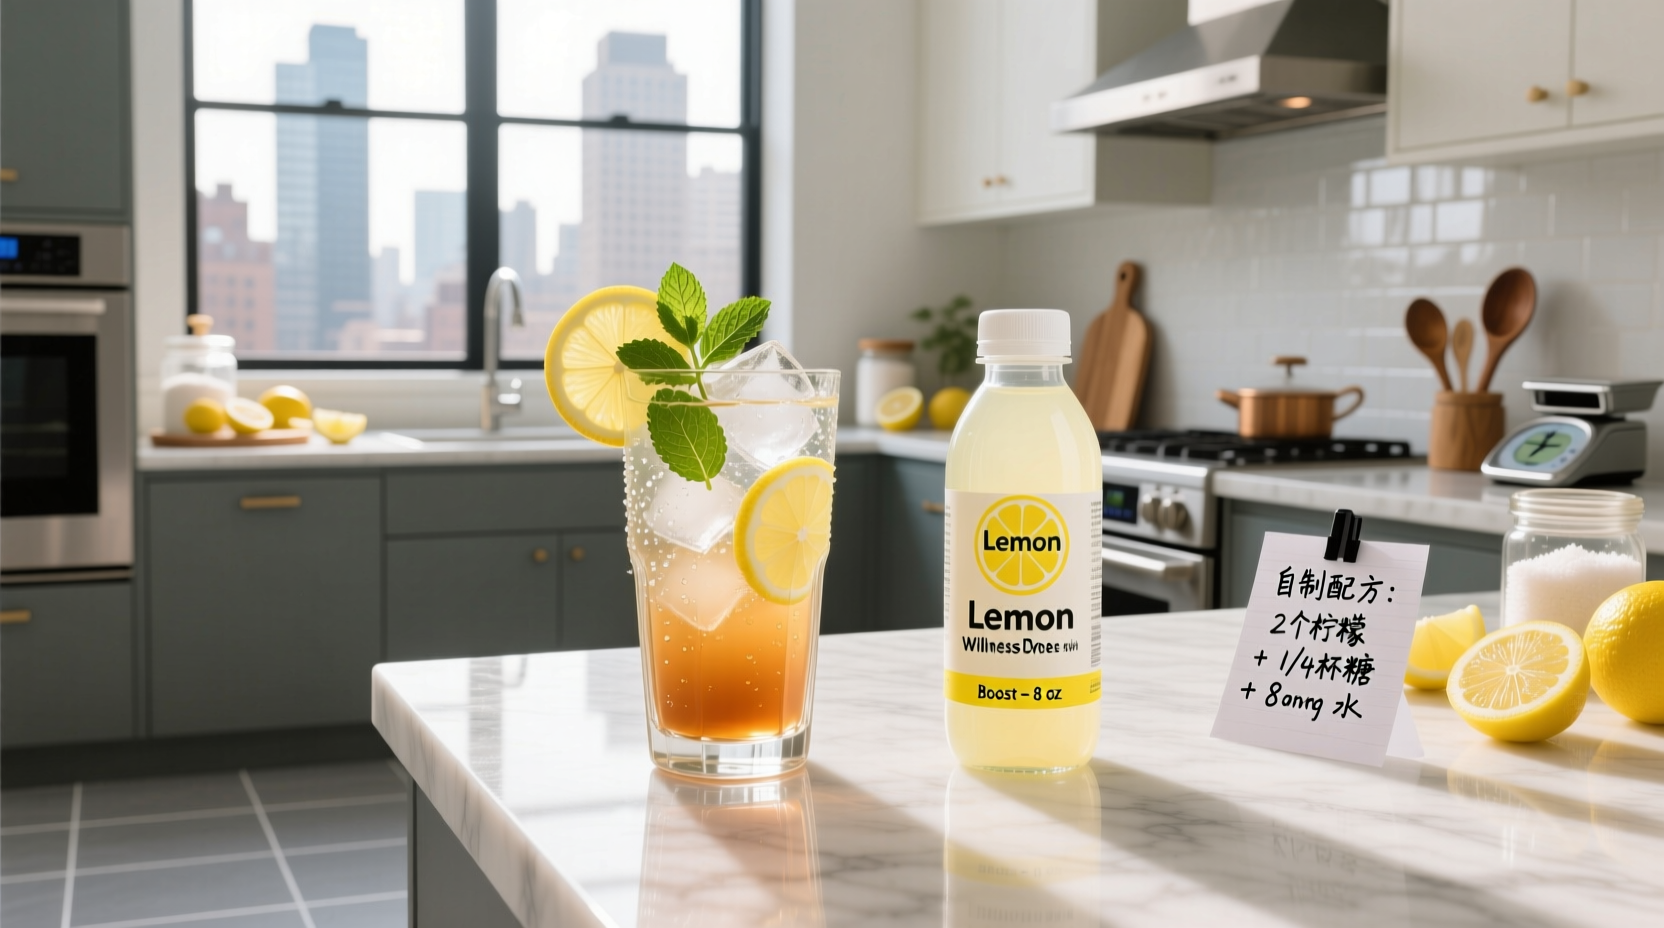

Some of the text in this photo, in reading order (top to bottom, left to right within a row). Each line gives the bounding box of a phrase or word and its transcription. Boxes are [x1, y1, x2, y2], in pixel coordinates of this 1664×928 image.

[983, 529, 1061, 552] Lemon
[968, 599, 1074, 631] Lemon
[1269, 609, 1367, 648] 2个柠檬
[1279, 646, 1376, 687] 1/4杯糖
[977, 683, 1018, 701] Boost
[1033, 686, 1042, 701] 8
[1045, 688, 1063, 701] oz
[1332, 692, 1363, 719] 水
